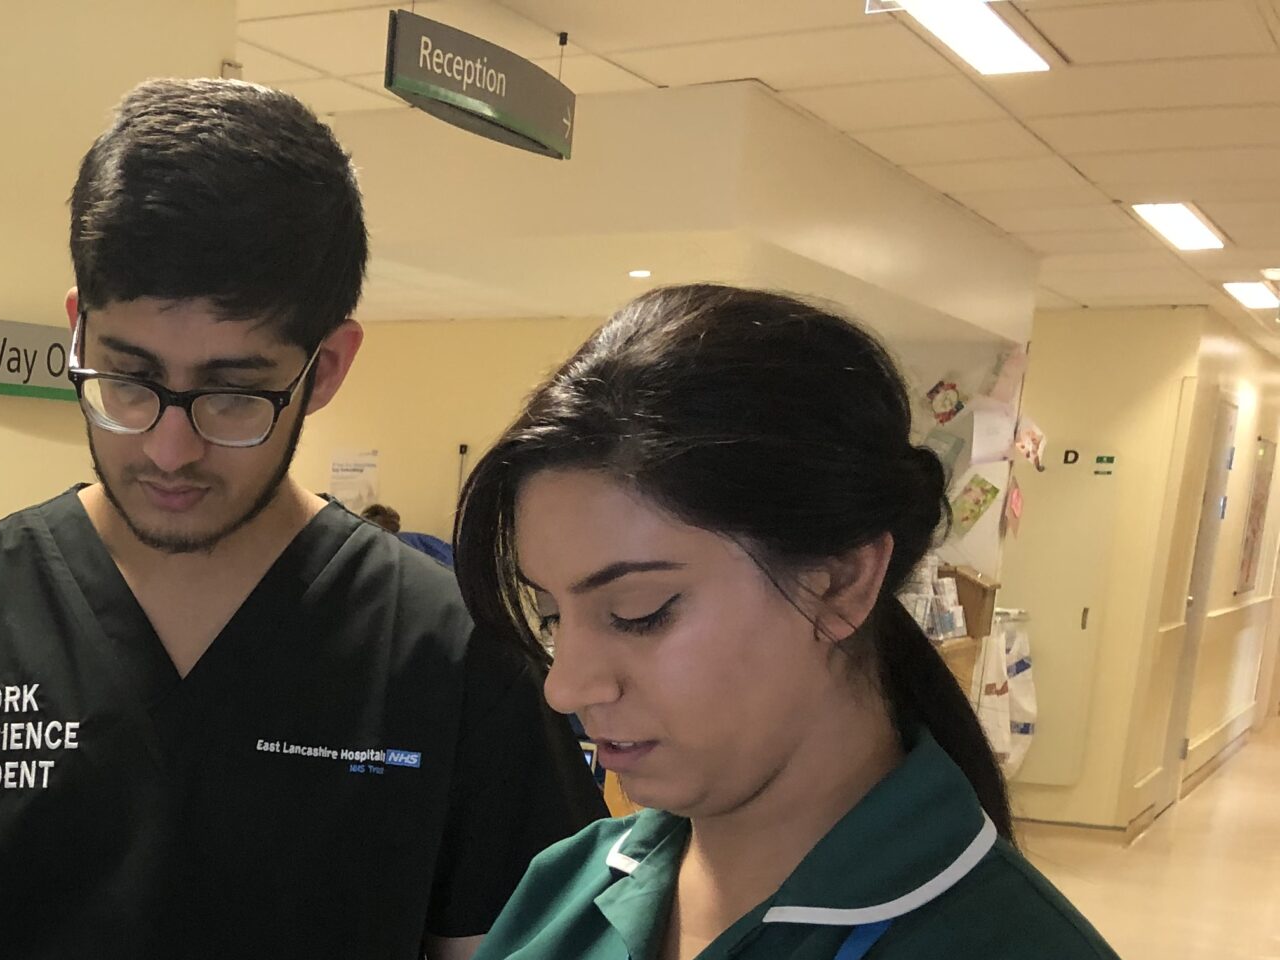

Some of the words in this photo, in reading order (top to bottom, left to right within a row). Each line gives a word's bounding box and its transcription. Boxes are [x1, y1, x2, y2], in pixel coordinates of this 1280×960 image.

[419, 35, 507, 97] Reception
[1063, 449, 1080, 464] D
[256, 739, 281, 752] East
[282, 741, 338, 760] Lancashire
[387, 752, 419, 765] NHS
